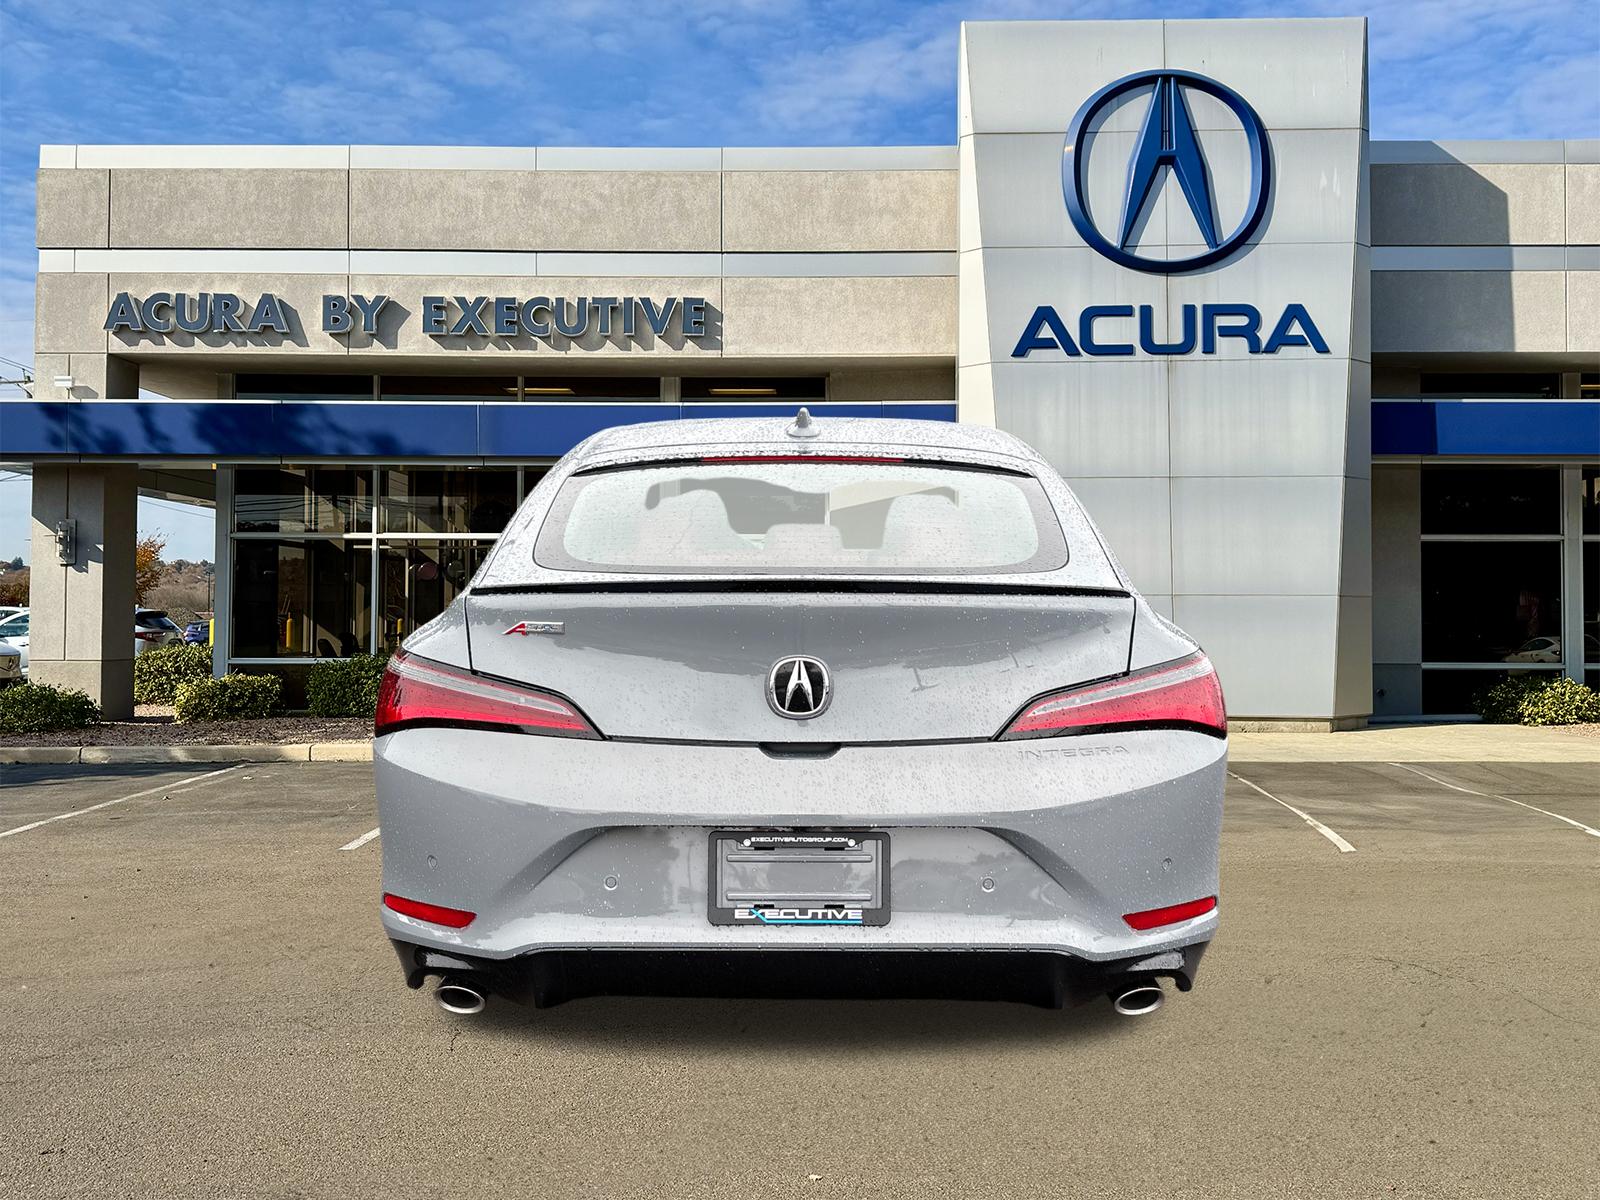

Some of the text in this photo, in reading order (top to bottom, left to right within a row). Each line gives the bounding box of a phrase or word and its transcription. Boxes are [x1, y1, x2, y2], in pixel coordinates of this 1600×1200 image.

[103, 292, 707, 336] ACURA BY EXECUTIVE
[1011, 303, 1332, 357] ACURA
[1017, 745, 1129, 760] INTEGRA
[734, 908, 863, 920] EXECUTIVE
